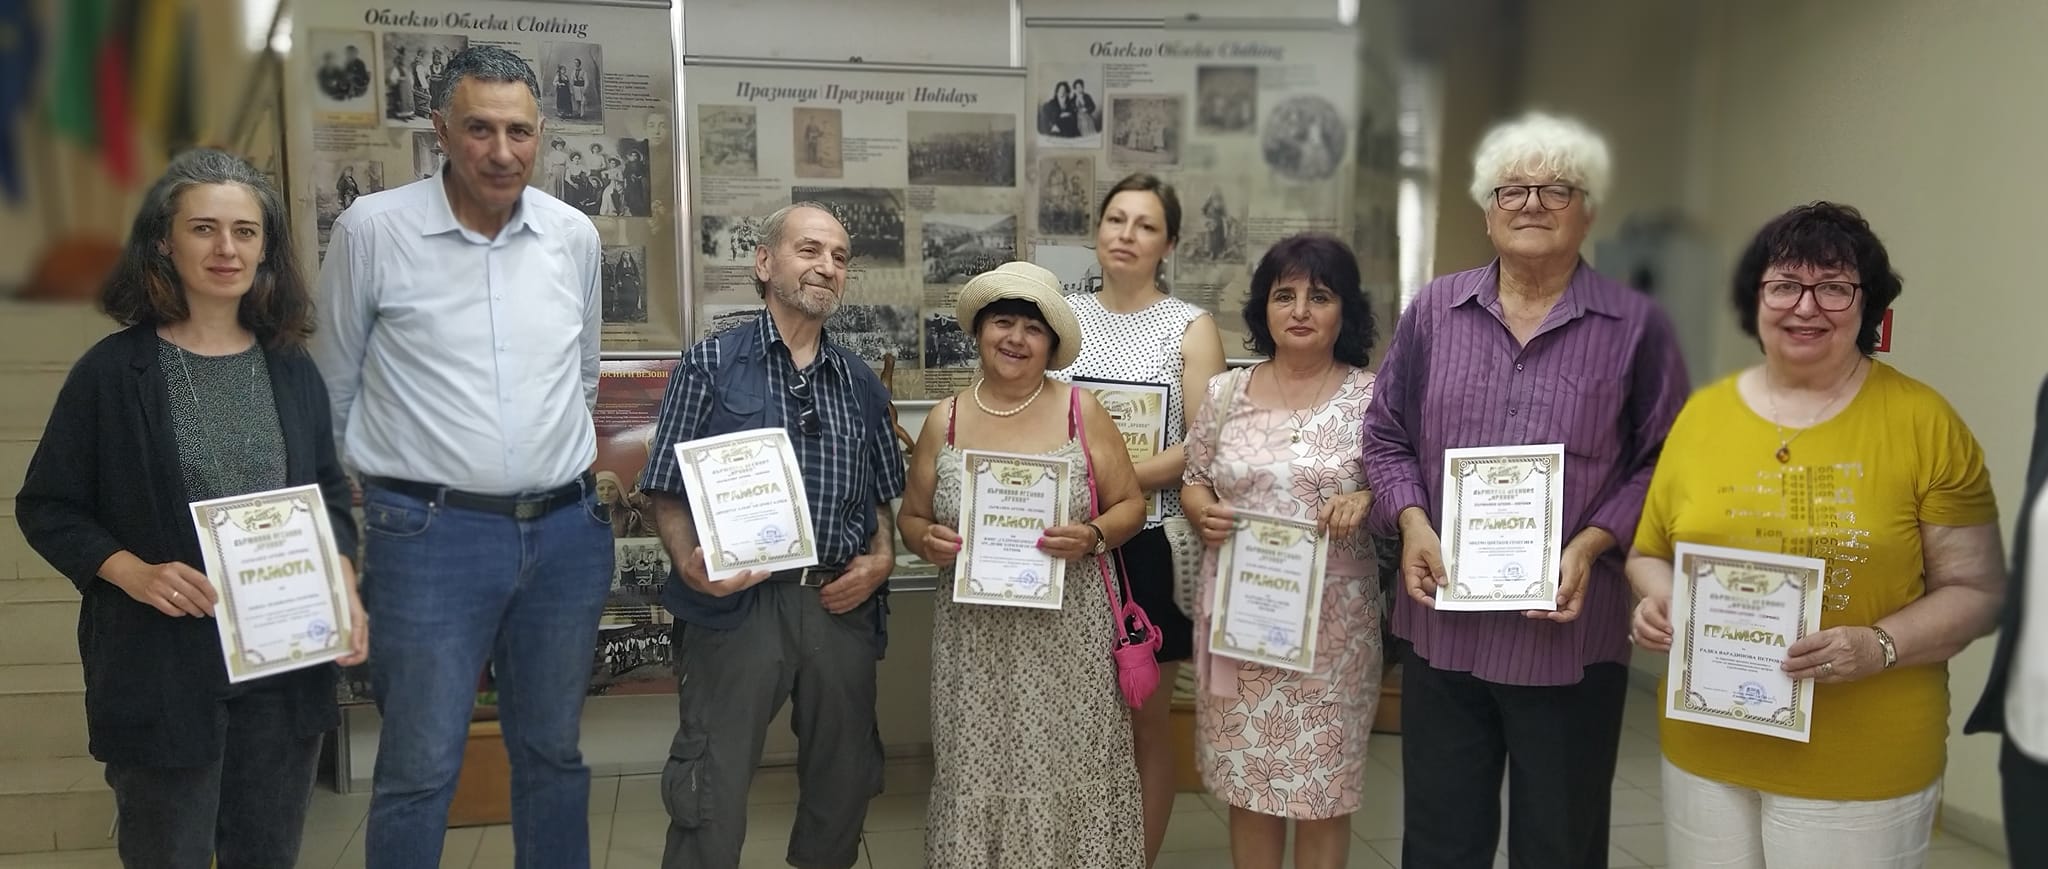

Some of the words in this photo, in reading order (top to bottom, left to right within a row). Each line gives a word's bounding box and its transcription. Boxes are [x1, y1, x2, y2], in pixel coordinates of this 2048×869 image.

[364, 8, 439, 28] Облекло
[444, 12, 509, 31] Облека
[517, 15, 589, 38] Clothing
[1090, 41, 1153, 58] Облекло
[736, 81, 818, 103] Празници
[825, 84, 905, 105] Празници
[913, 87, 978, 108] Holidays
[715, 482, 781, 504] ГРАМОТА
[983, 513, 1045, 530] ГРАМОТА
[1468, 516, 1537, 530] ГРАМОТА
[238, 558, 316, 586] ГРАМОТА
[1240, 570, 1300, 595] ГРАМОТА
[1703, 623, 1787, 648] ГРАМОТА
